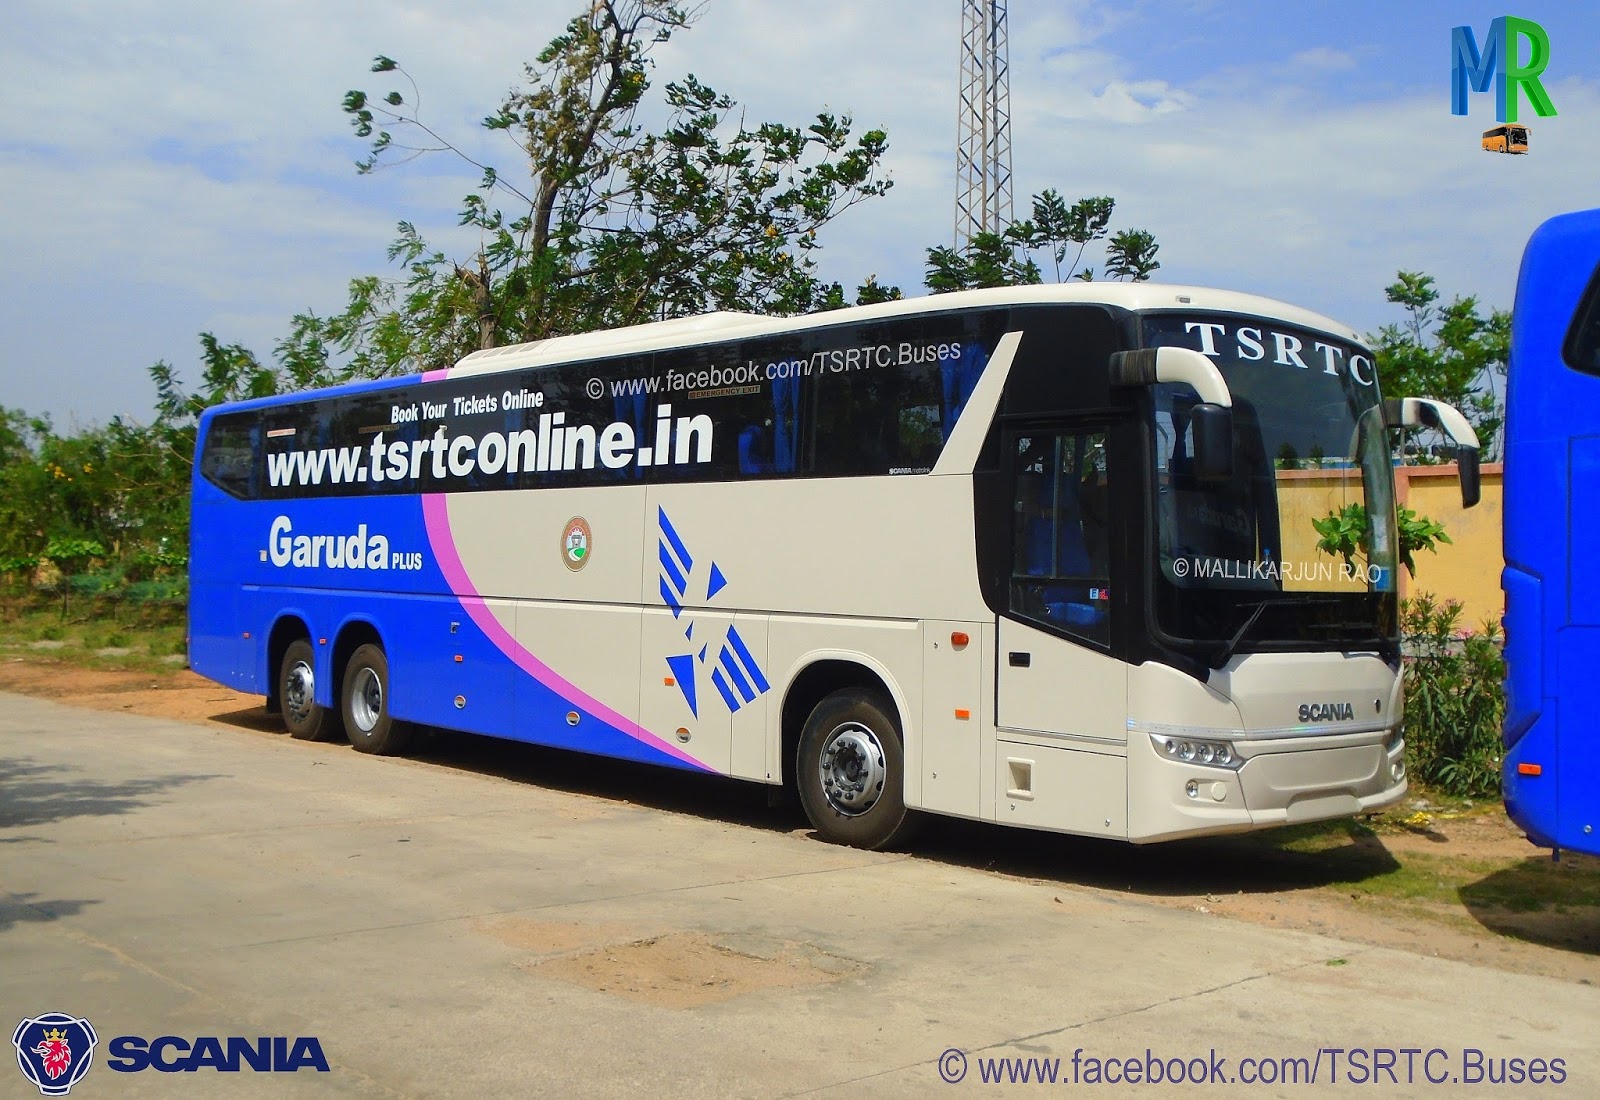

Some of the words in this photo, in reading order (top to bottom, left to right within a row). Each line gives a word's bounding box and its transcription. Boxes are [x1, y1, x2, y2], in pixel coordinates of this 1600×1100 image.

[1185, 322, 1373, 386] TSRTC
[391, 403, 419, 424] Book
[421, 401, 448, 420] Your
[453, 394, 498, 416] Tickets
[502, 388, 544, 411] Online
[696, 388, 740, 397] EMERGENCY
[267, 404, 713, 486] www.tsrtconline.in
[269, 515, 389, 570] Garuda
[391, 552, 423, 571] PLUS
[1298, 703, 1354, 723] SCANIA
